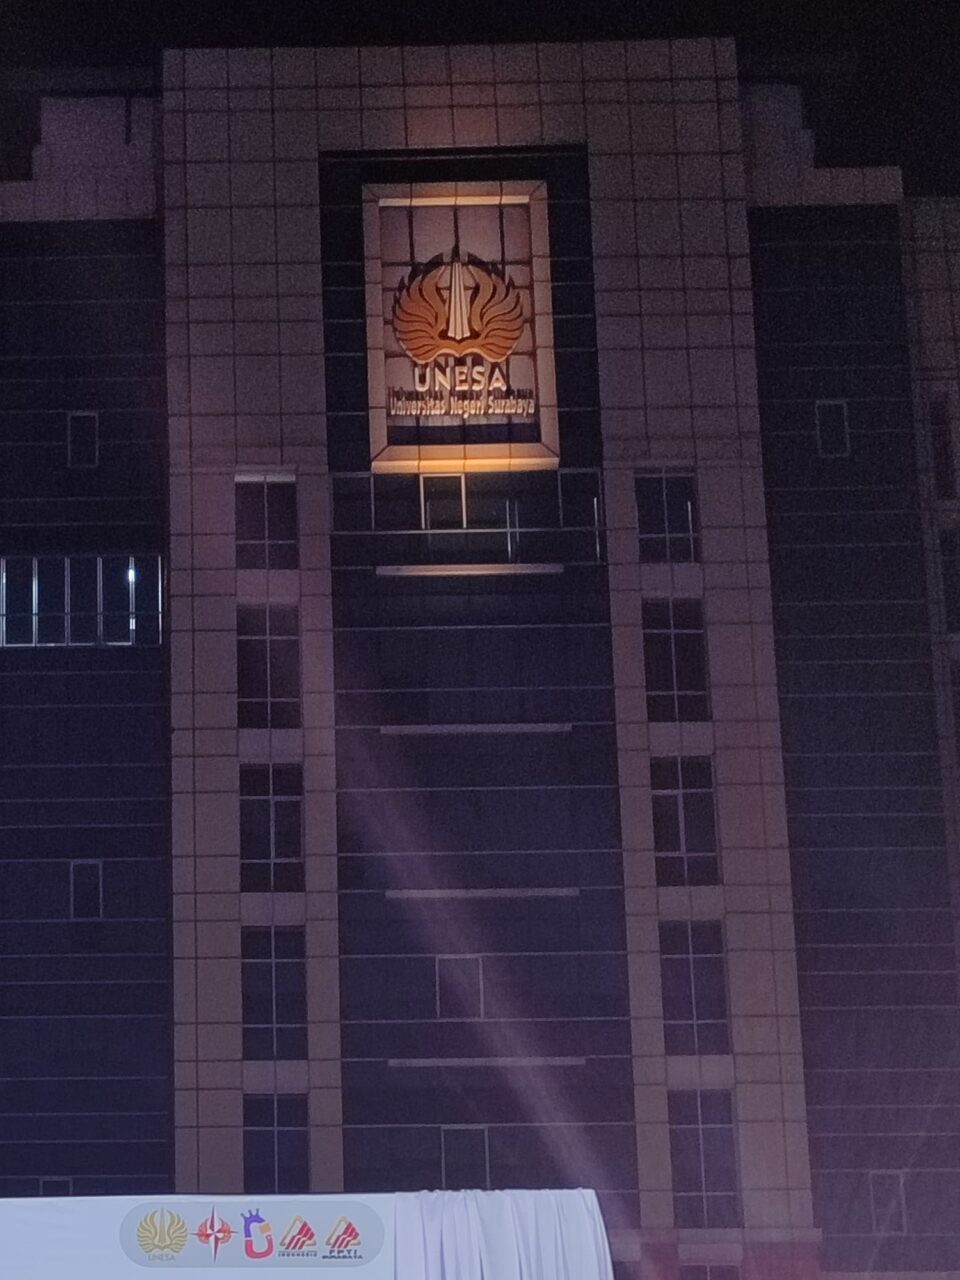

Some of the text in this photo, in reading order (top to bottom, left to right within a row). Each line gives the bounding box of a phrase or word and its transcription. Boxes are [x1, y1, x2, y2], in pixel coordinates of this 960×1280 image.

[414, 365, 507, 391] UNESA
[390, 396, 535, 418] Universitas Negeri Surabaya
